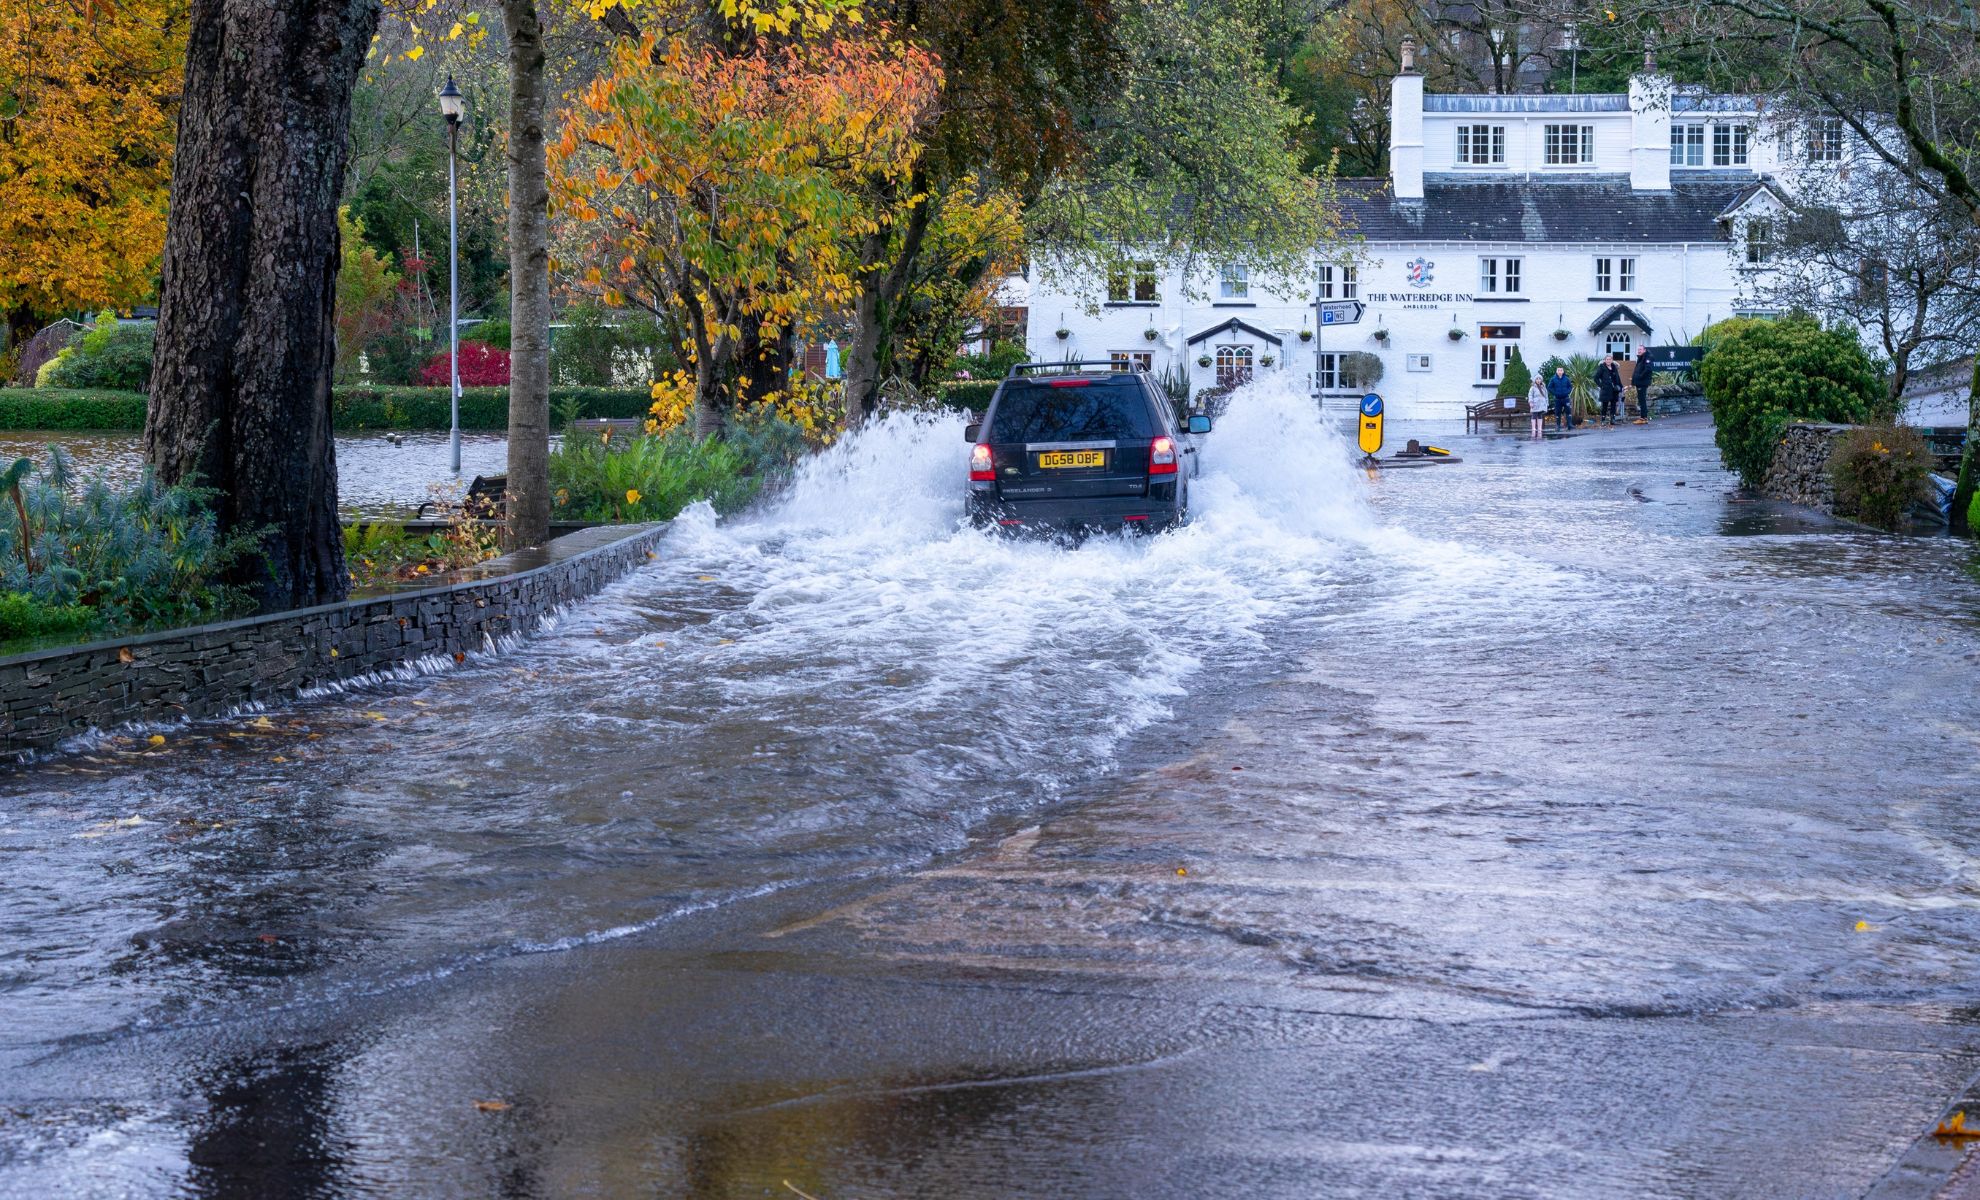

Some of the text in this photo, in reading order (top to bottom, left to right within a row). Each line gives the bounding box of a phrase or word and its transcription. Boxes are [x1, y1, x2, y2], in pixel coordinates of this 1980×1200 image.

[1367, 293, 1473, 302] THE WATEREDGE INN
[1335, 312, 1344, 321] WC
[1044, 452, 1100, 466] DG58 OBF
